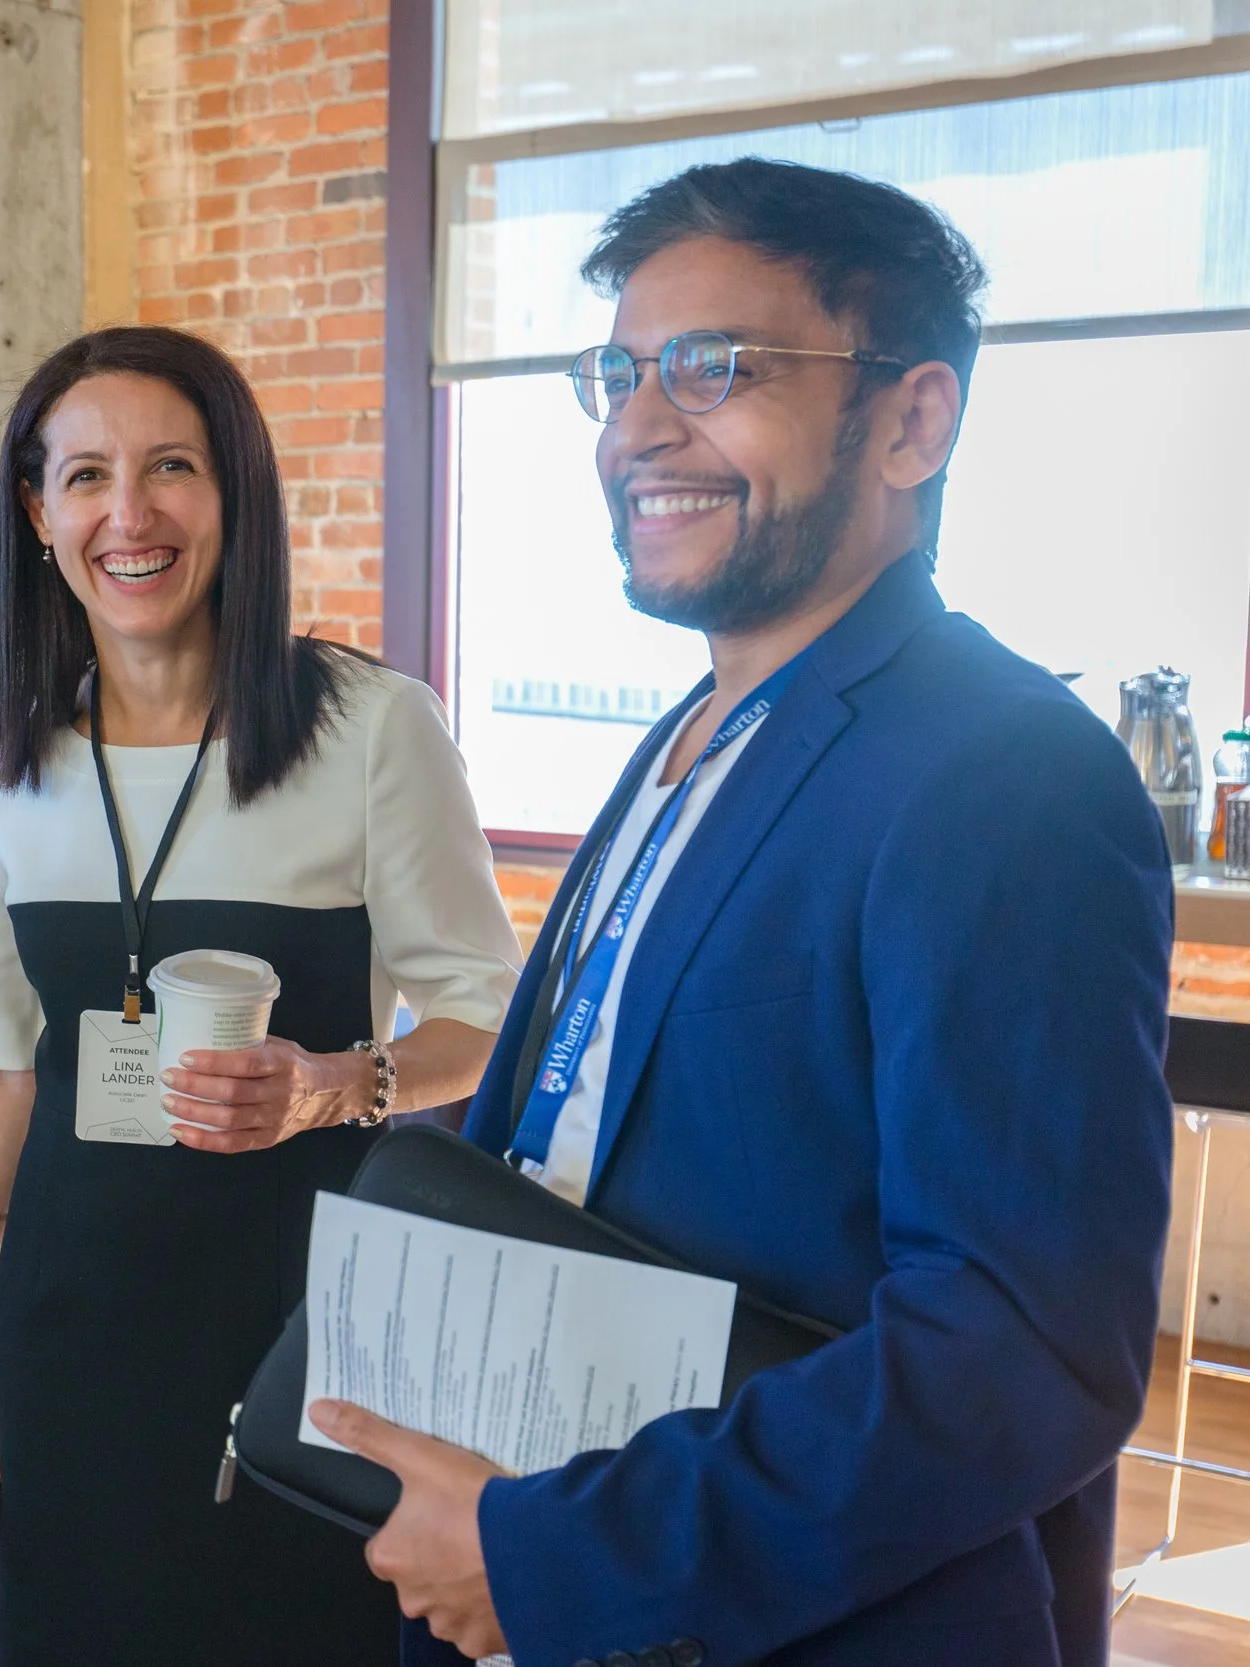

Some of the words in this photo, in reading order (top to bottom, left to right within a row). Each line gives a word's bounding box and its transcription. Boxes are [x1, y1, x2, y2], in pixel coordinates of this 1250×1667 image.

[616, 843, 656, 913] Wharton
[547, 998, 590, 1068] Wharton
[109, 1047, 150, 1056] ATTENDEE
[114, 1061, 144, 1072] LINA
[102, 1072, 155, 1086] LANDER
